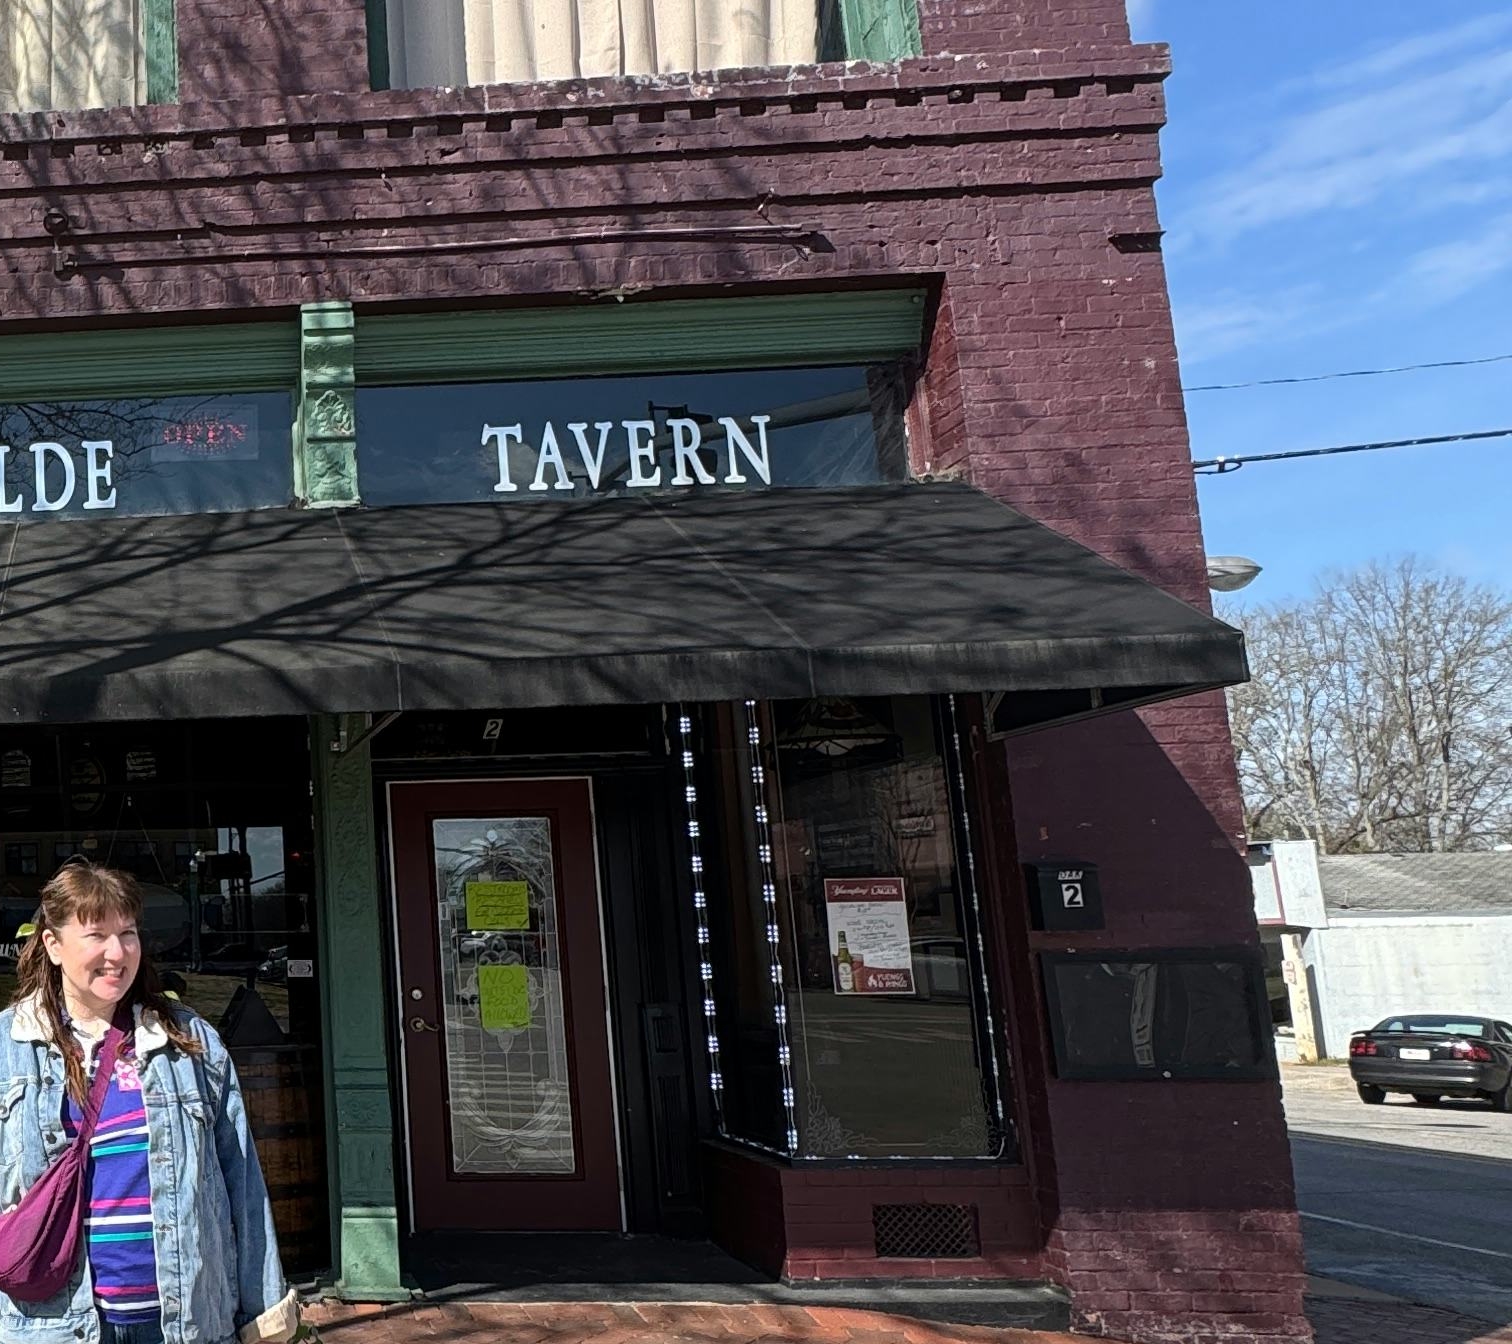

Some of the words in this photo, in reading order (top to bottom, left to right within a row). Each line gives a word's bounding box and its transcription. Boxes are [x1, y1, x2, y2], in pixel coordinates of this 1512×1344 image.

[163, 423, 248, 444] OPEN
[481, 415, 774, 494] TAVERN
[485, 720, 500, 737] 2
[1064, 885, 1081, 906] 2
[483, 969, 514, 985] NO
